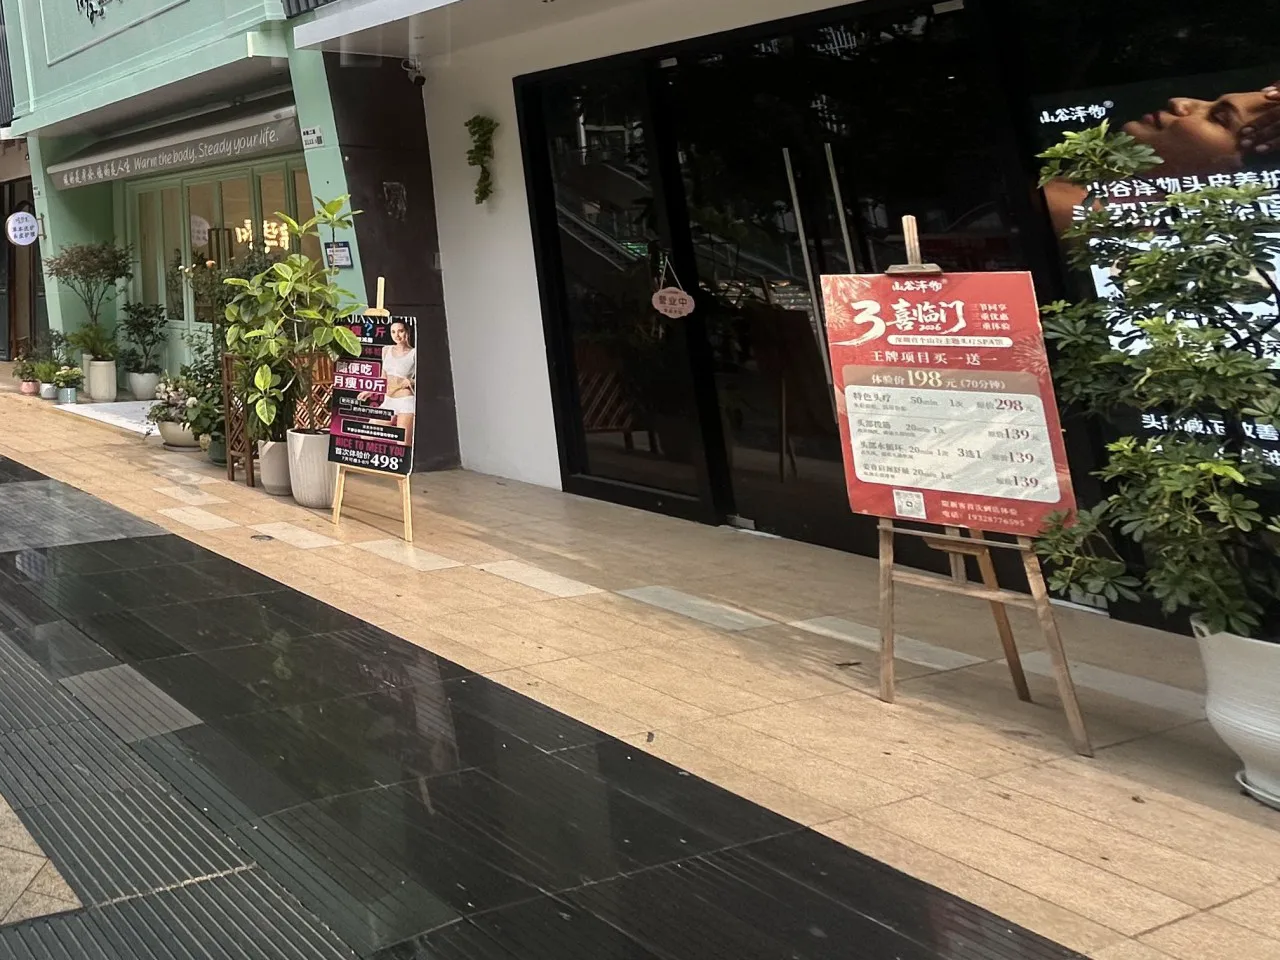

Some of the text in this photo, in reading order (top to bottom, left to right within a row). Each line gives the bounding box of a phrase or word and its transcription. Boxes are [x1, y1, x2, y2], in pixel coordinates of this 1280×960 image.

[134, 154, 158, 171] Warm
[158, 150, 172, 167] the
[173, 145, 197, 165] body.
[198, 140, 233, 159] Steady
[232, 136, 260, 157] your
[259, 127, 279, 147] life.
[333, 375, 386, 392] 月瘦10斤
[370, 454, 399, 471] 498
